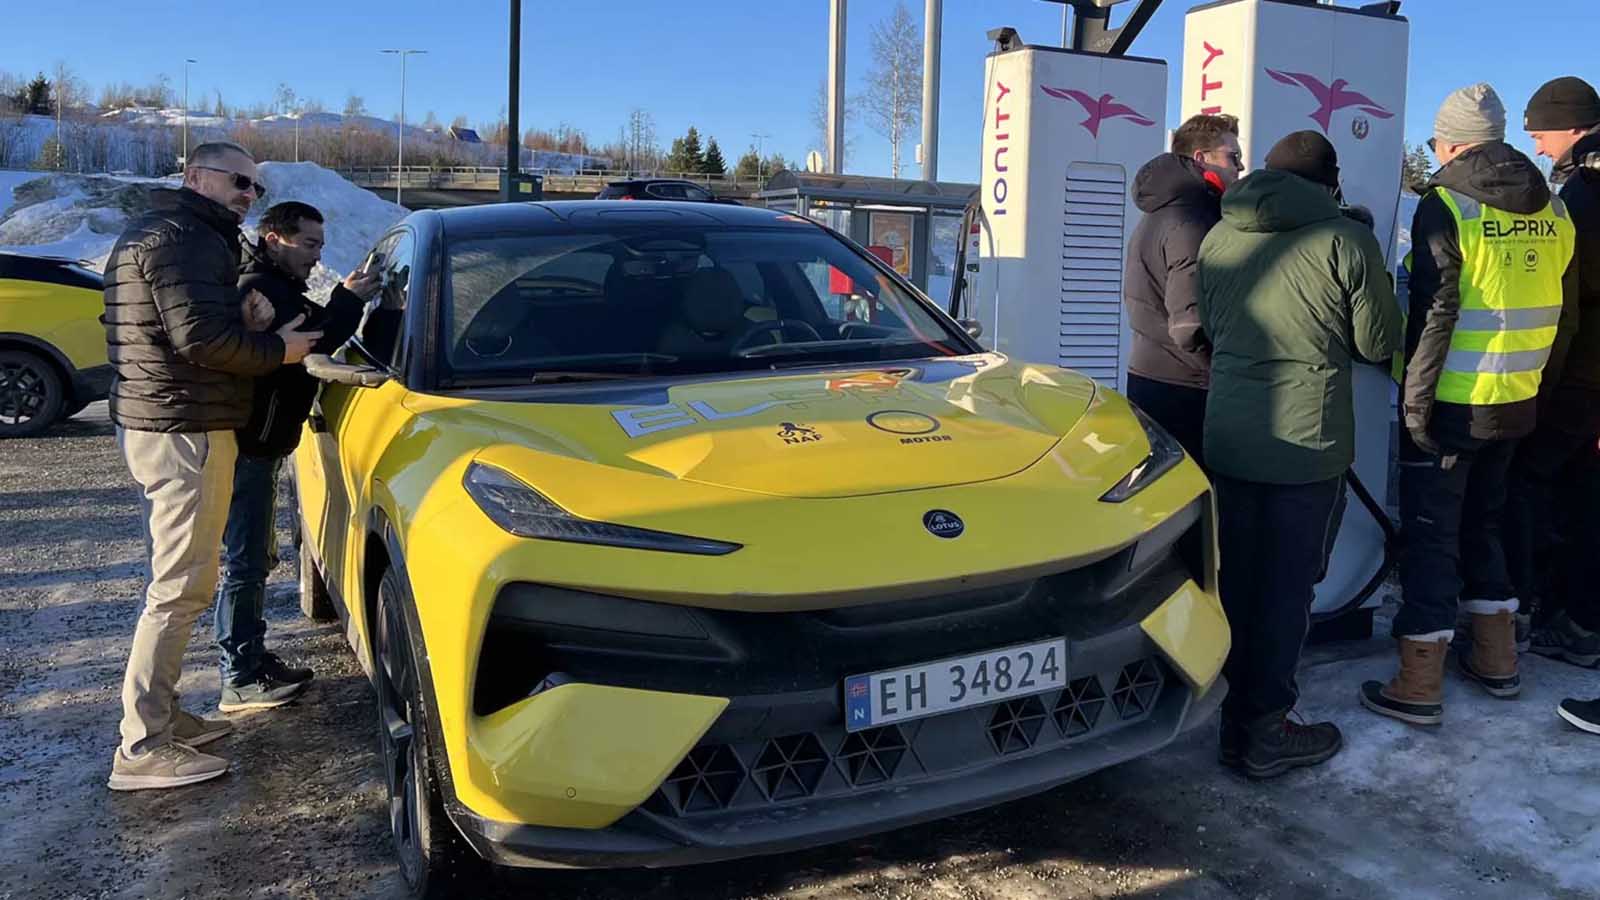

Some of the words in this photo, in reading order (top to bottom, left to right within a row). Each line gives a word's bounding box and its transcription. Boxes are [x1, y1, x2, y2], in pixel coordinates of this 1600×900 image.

[1201, 41, 1224, 115] ITY
[993, 81, 1010, 215] IONITY
[783, 433, 823, 445] NAF
[900, 434, 953, 445] MOTOR
[930, 521, 960, 530] LOTUS
[880, 671, 927, 716] EH
[949, 647, 1059, 702] 34824
[854, 707, 865, 720] N
